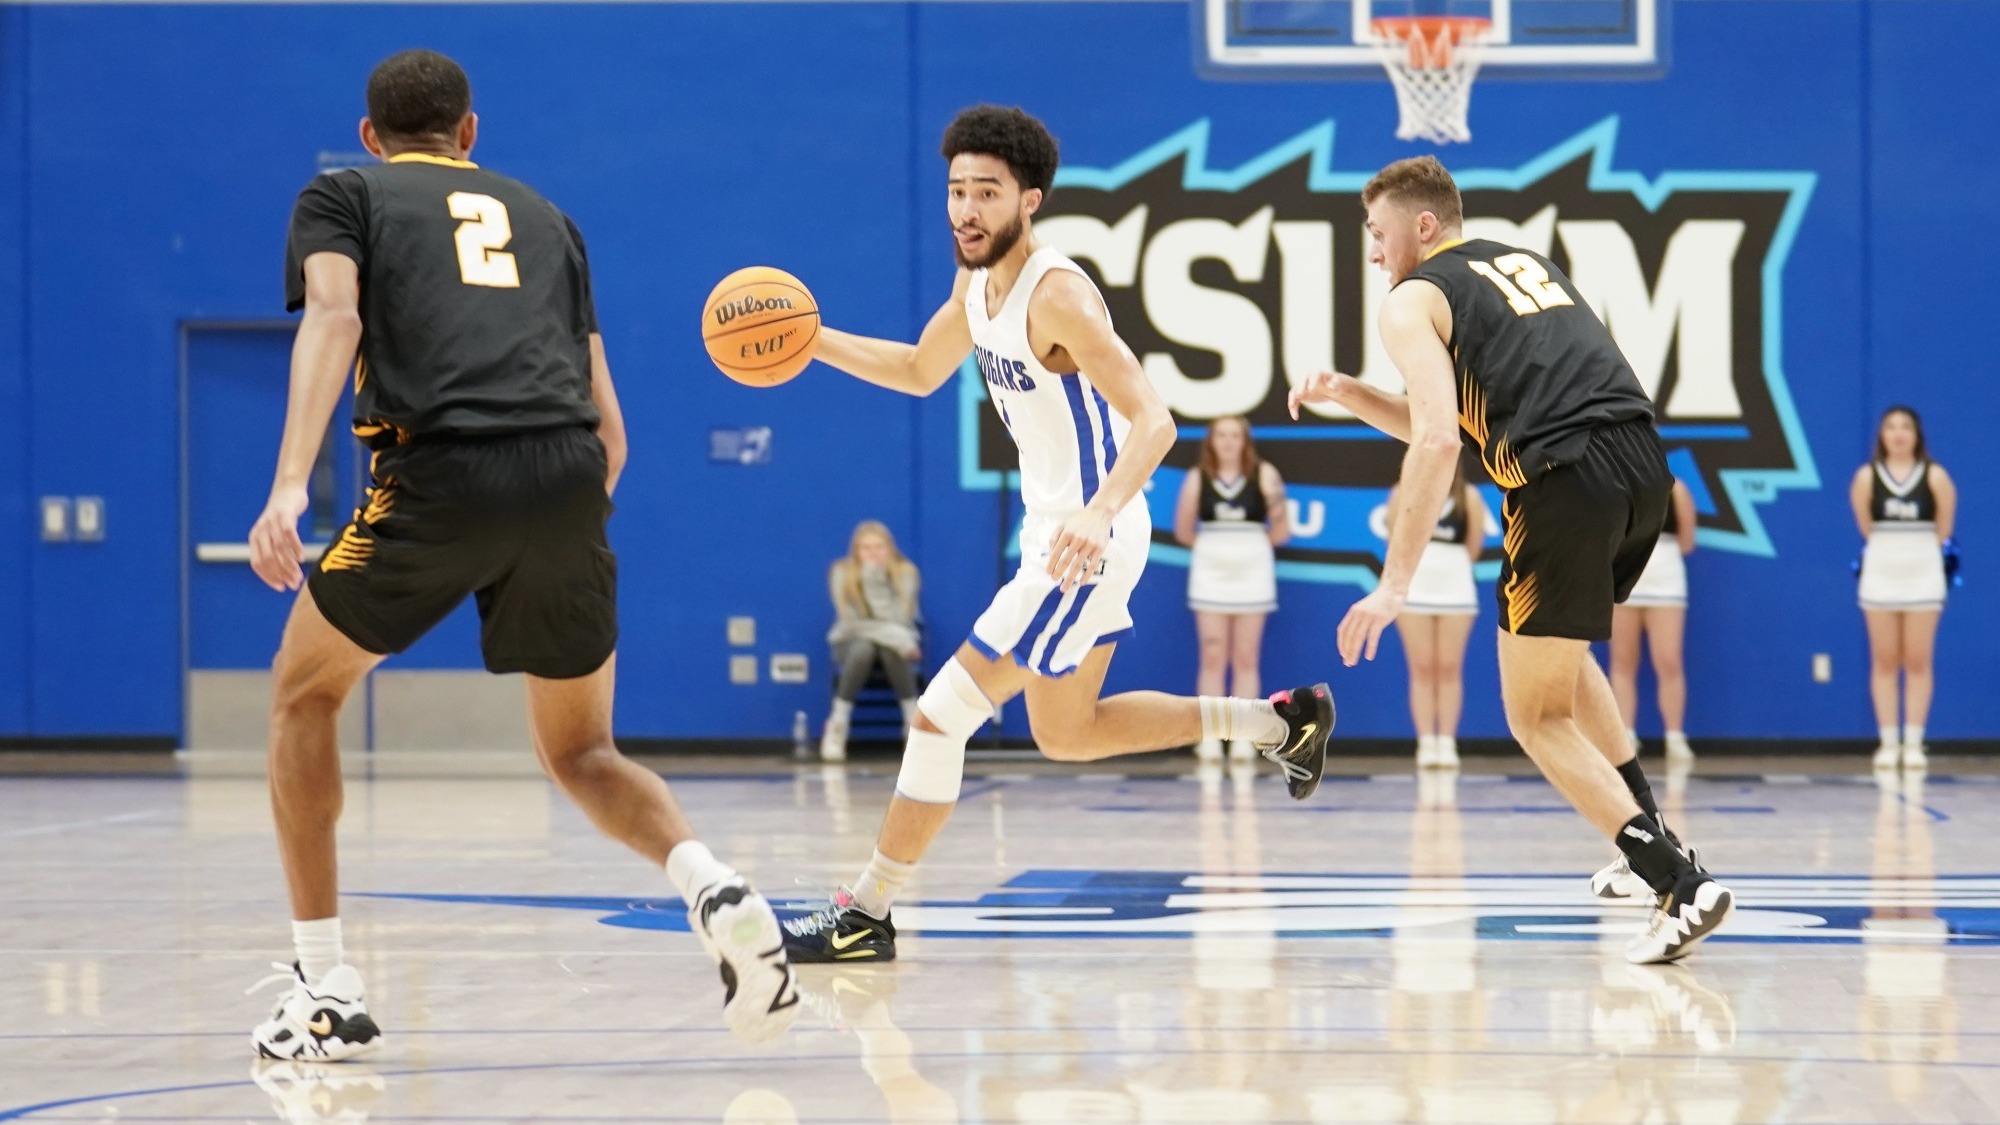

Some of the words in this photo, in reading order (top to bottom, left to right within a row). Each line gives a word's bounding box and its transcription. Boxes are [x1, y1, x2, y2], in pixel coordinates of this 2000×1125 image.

[446, 190, 521, 289] 2
[715, 294, 794, 326] Wilson
[1466, 252, 1576, 317] 12
